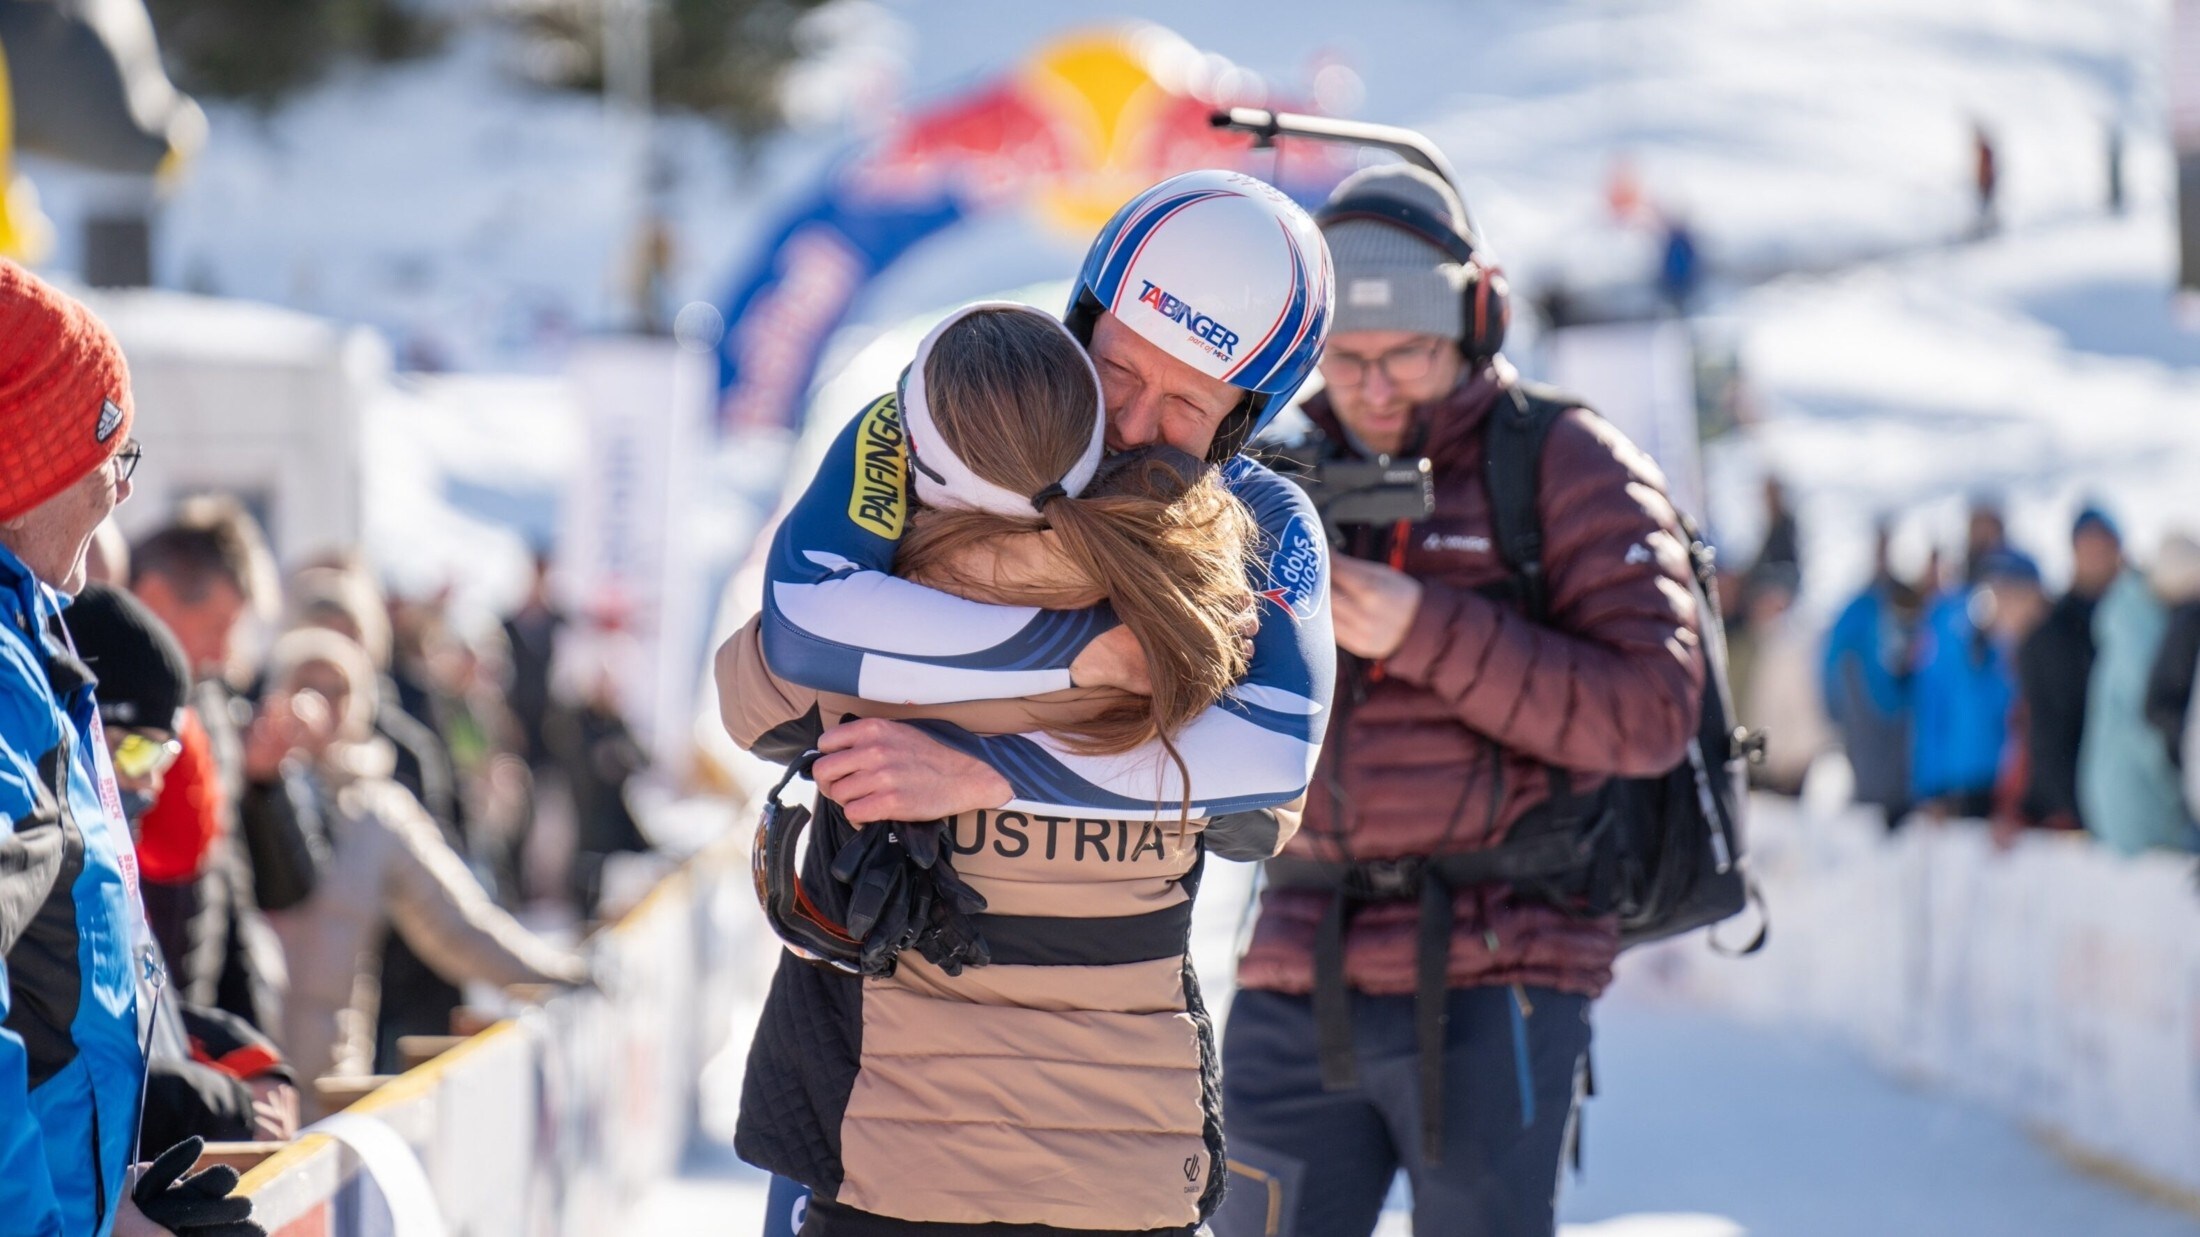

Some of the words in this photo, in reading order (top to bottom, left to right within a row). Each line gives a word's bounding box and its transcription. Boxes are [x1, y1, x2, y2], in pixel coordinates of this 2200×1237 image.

[1138, 279, 1240, 356] TAIBINGER
[1186, 335, 1205, 349] part
[1279, 535, 1314, 584] shop
[1295, 520, 1323, 613] personal
[950, 808, 1166, 863] USTRIA
